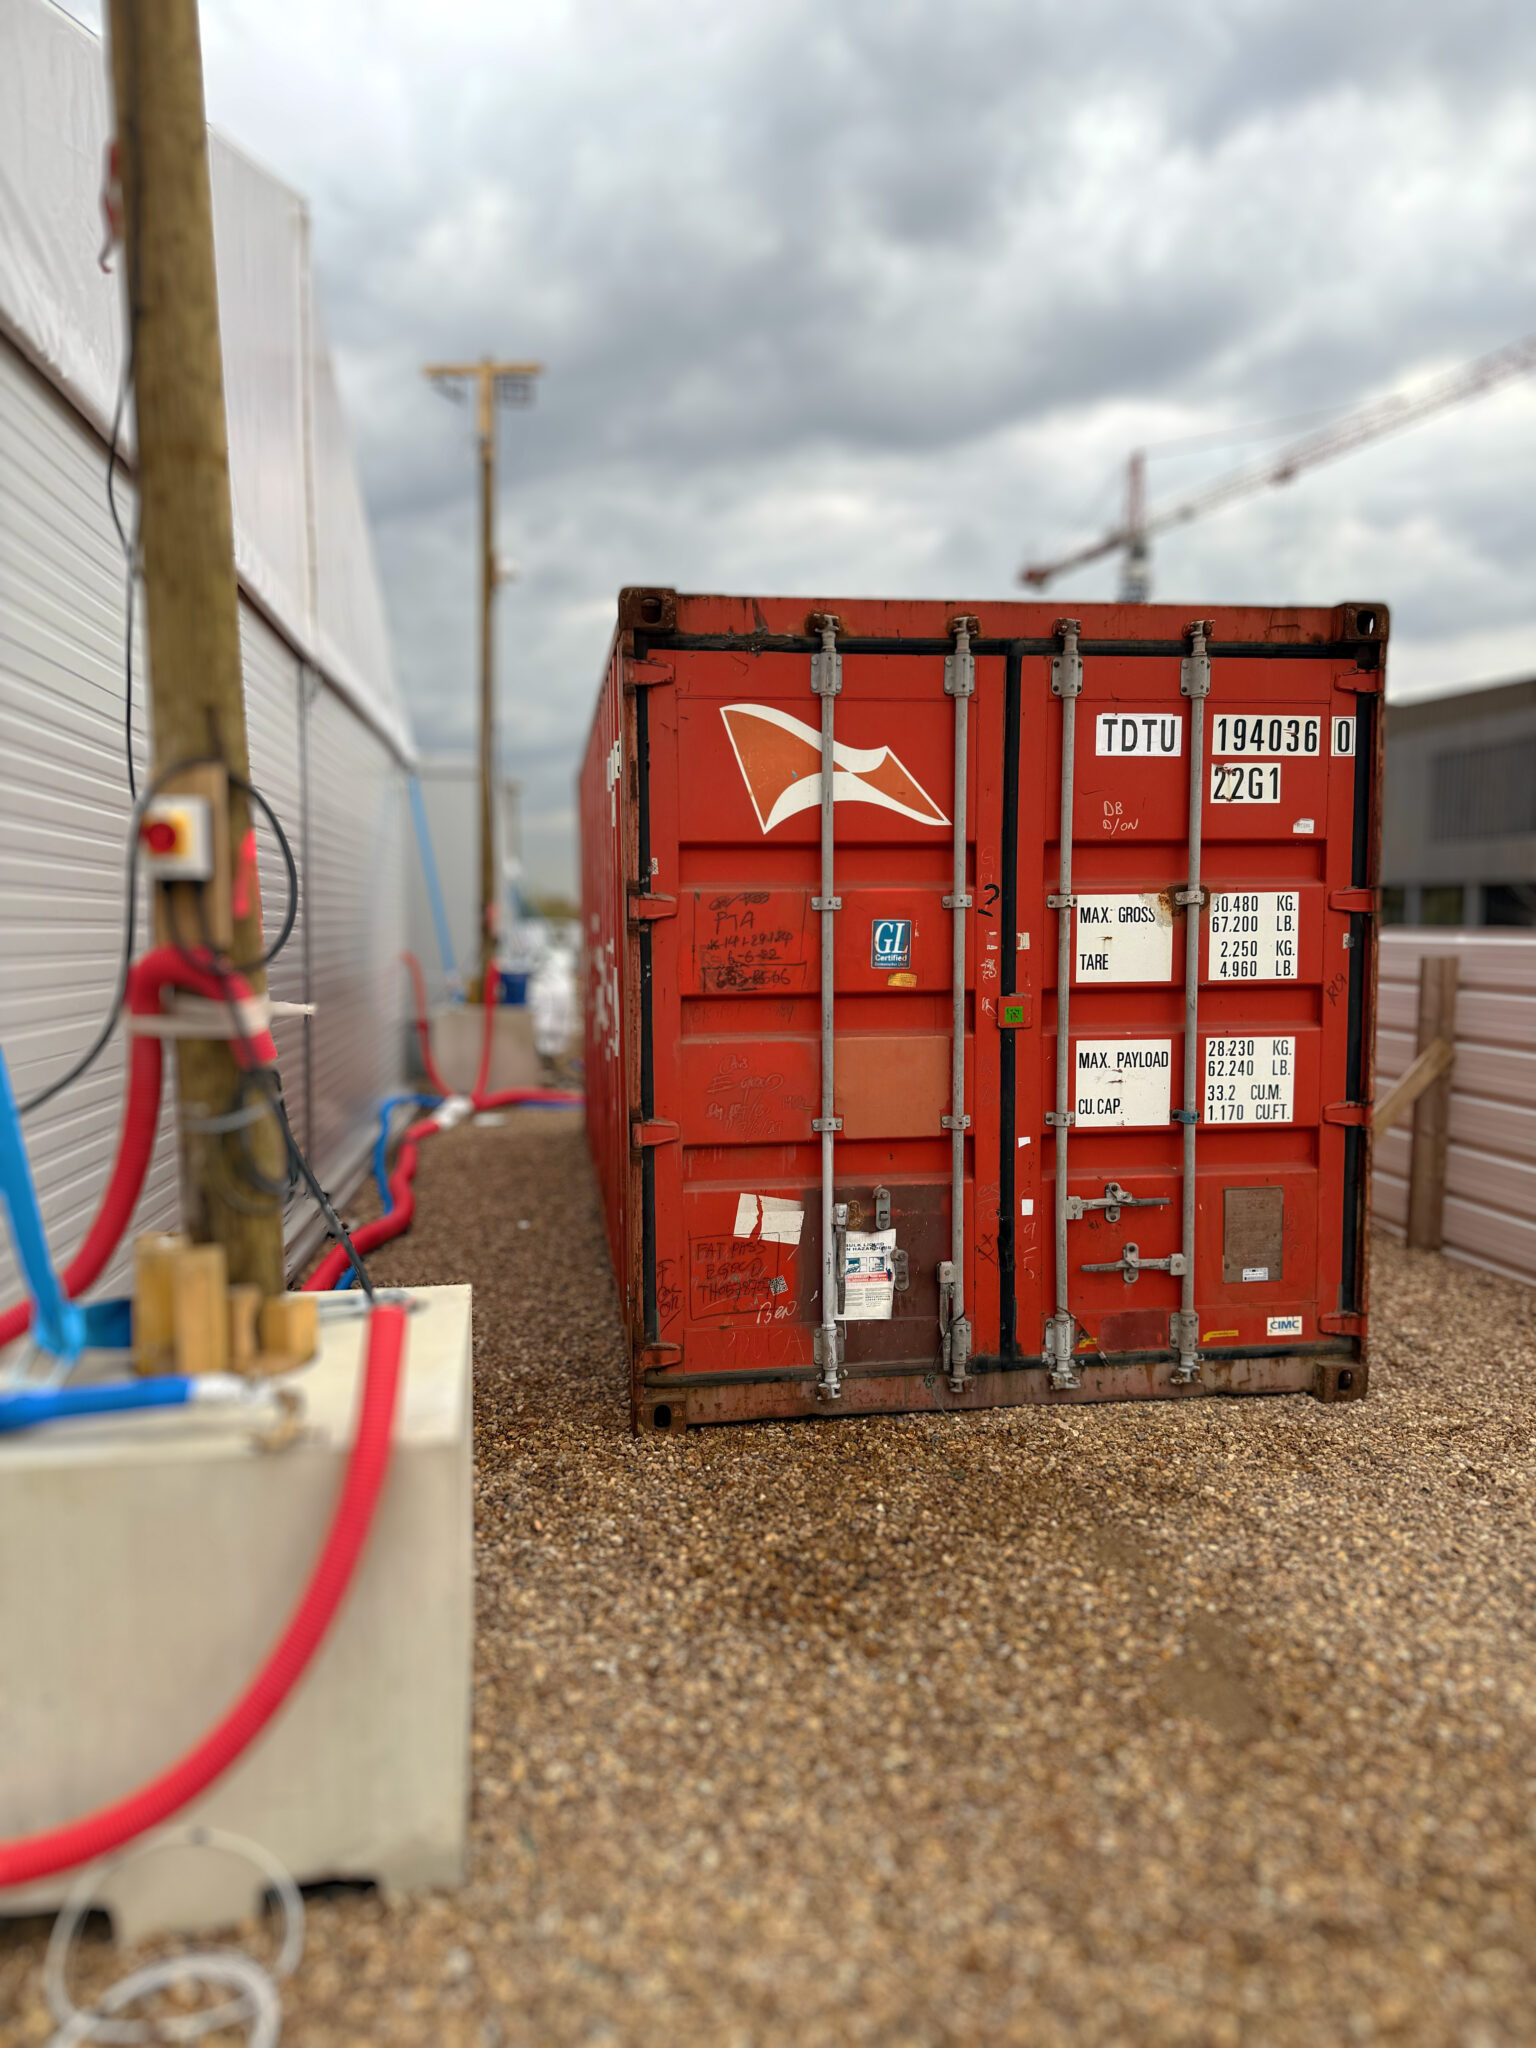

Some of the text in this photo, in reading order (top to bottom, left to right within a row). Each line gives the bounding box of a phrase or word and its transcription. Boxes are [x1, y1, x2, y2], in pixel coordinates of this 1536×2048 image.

[1102, 718, 1176, 752] TDTU
[1218, 718, 1350, 752] 194036 0
[1214, 767, 1278, 799] 22G1
[1276, 895, 1296, 912] KG.
[1080, 906, 1156, 924] MAX. GROSS
[1276, 915, 1295, 932] LB.
[874, 922, 908, 954] GL
[1276, 940, 1296, 957] KG.
[874, 953, 907, 962] Certified
[1080, 953, 1109, 971] TARE
[1275, 960, 1295, 977] LB.
[1272, 1040, 1292, 1056] KG.
[1079, 1051, 1169, 1069] MAX. PAYLOAD
[1272, 1060, 1291, 1076] LB.
[1207, 1084, 1236, 1101] 33.2
[1255, 1103, 1290, 1120] CU.FT.
[1269, 1319, 1300, 1330] CIMC
